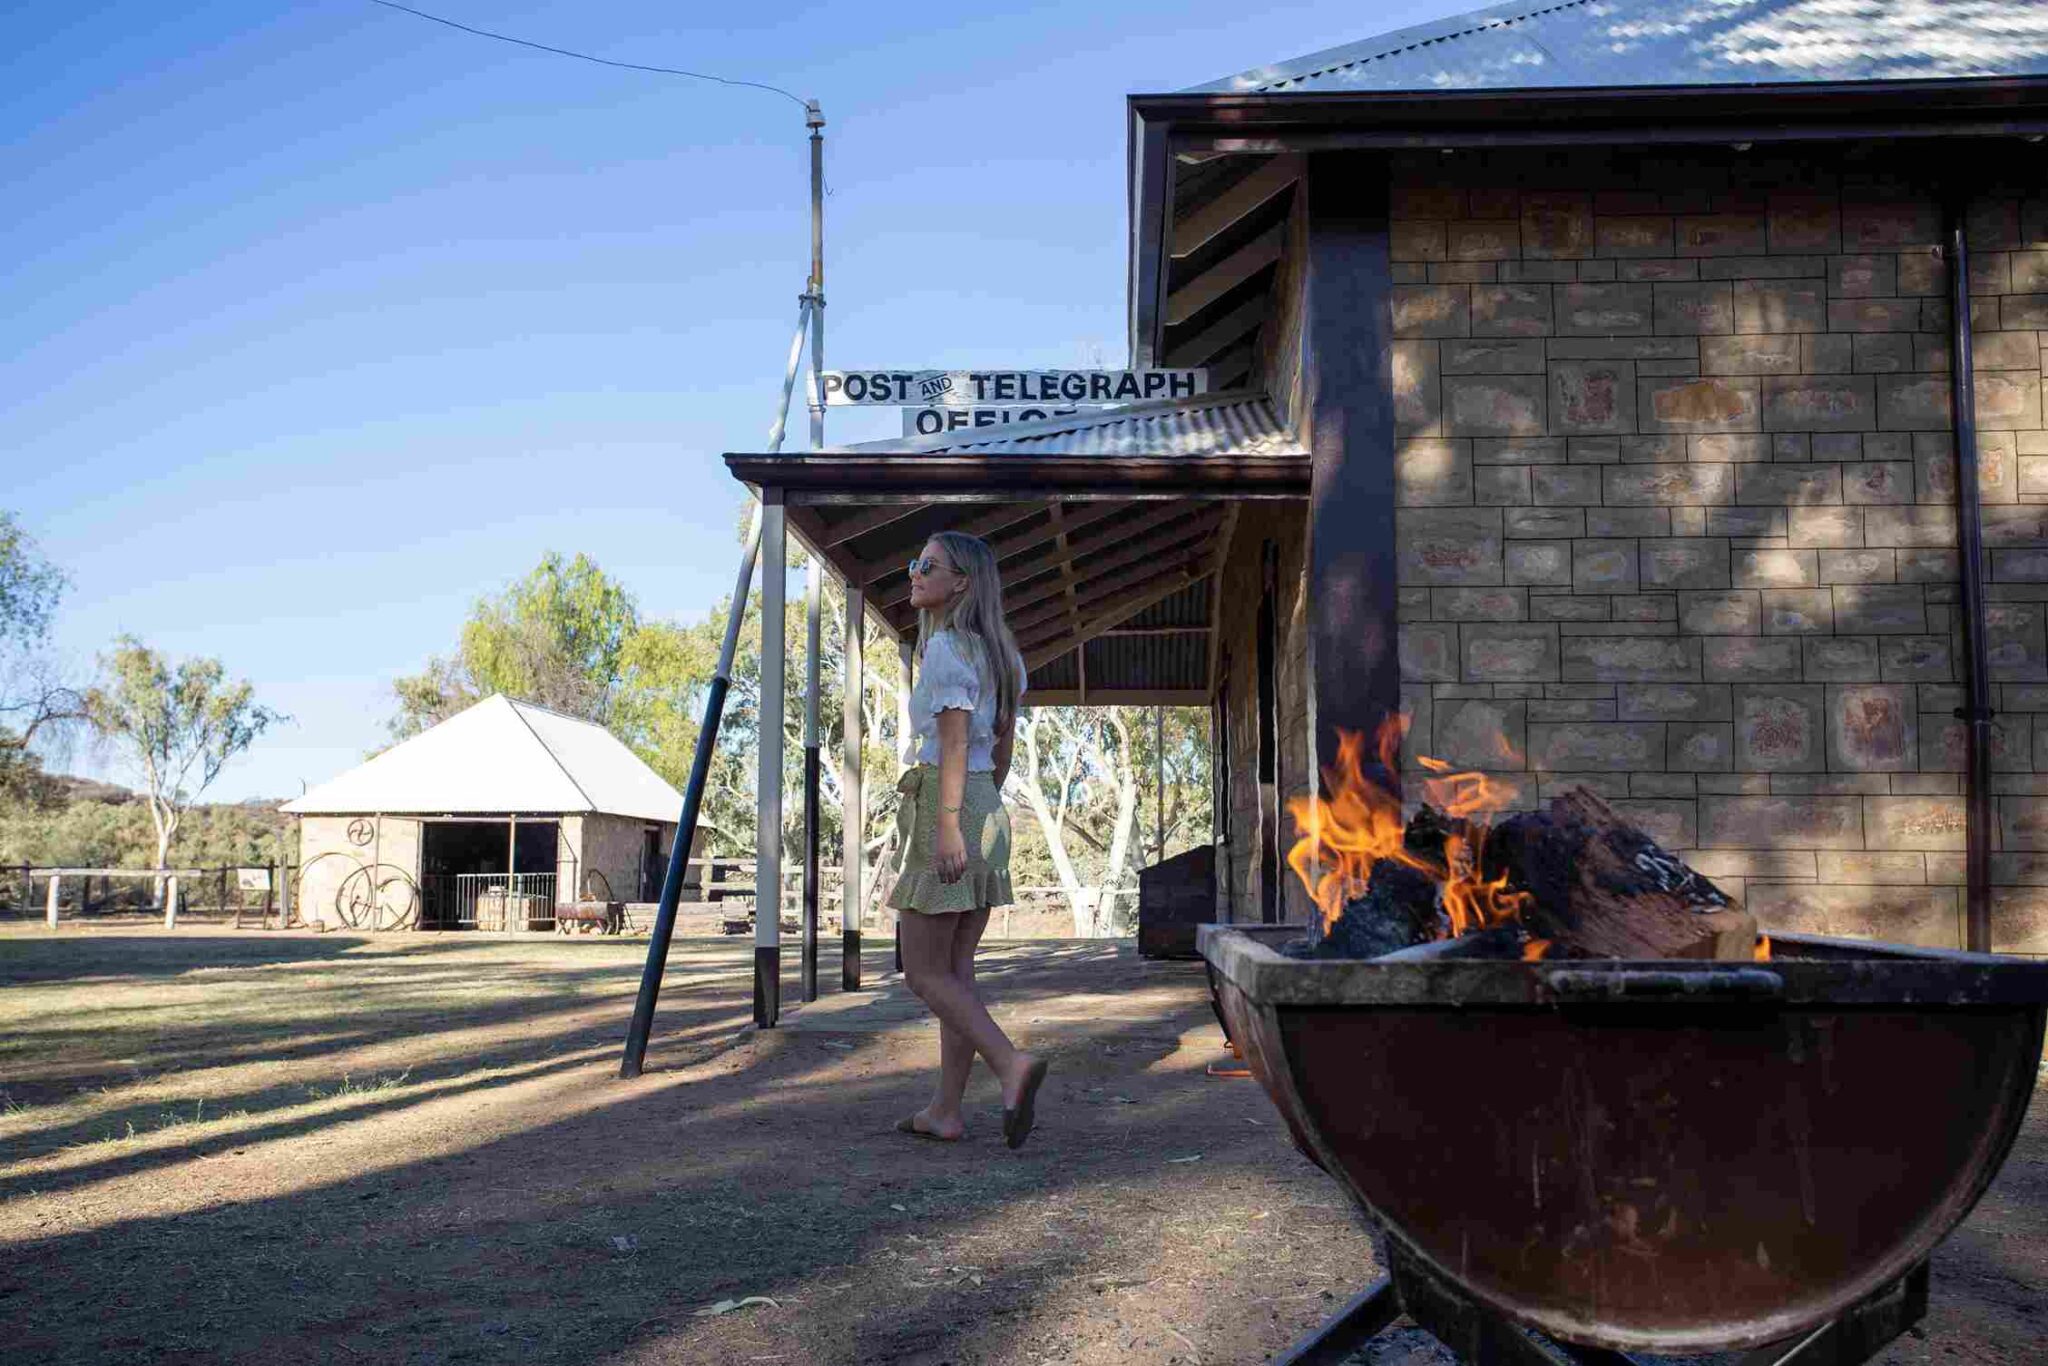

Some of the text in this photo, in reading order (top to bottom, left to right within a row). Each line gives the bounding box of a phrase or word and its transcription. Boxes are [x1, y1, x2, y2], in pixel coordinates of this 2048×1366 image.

[823, 372, 1195, 401] POST AND TELEGRAPH
[916, 409, 1077, 435] OFFI
